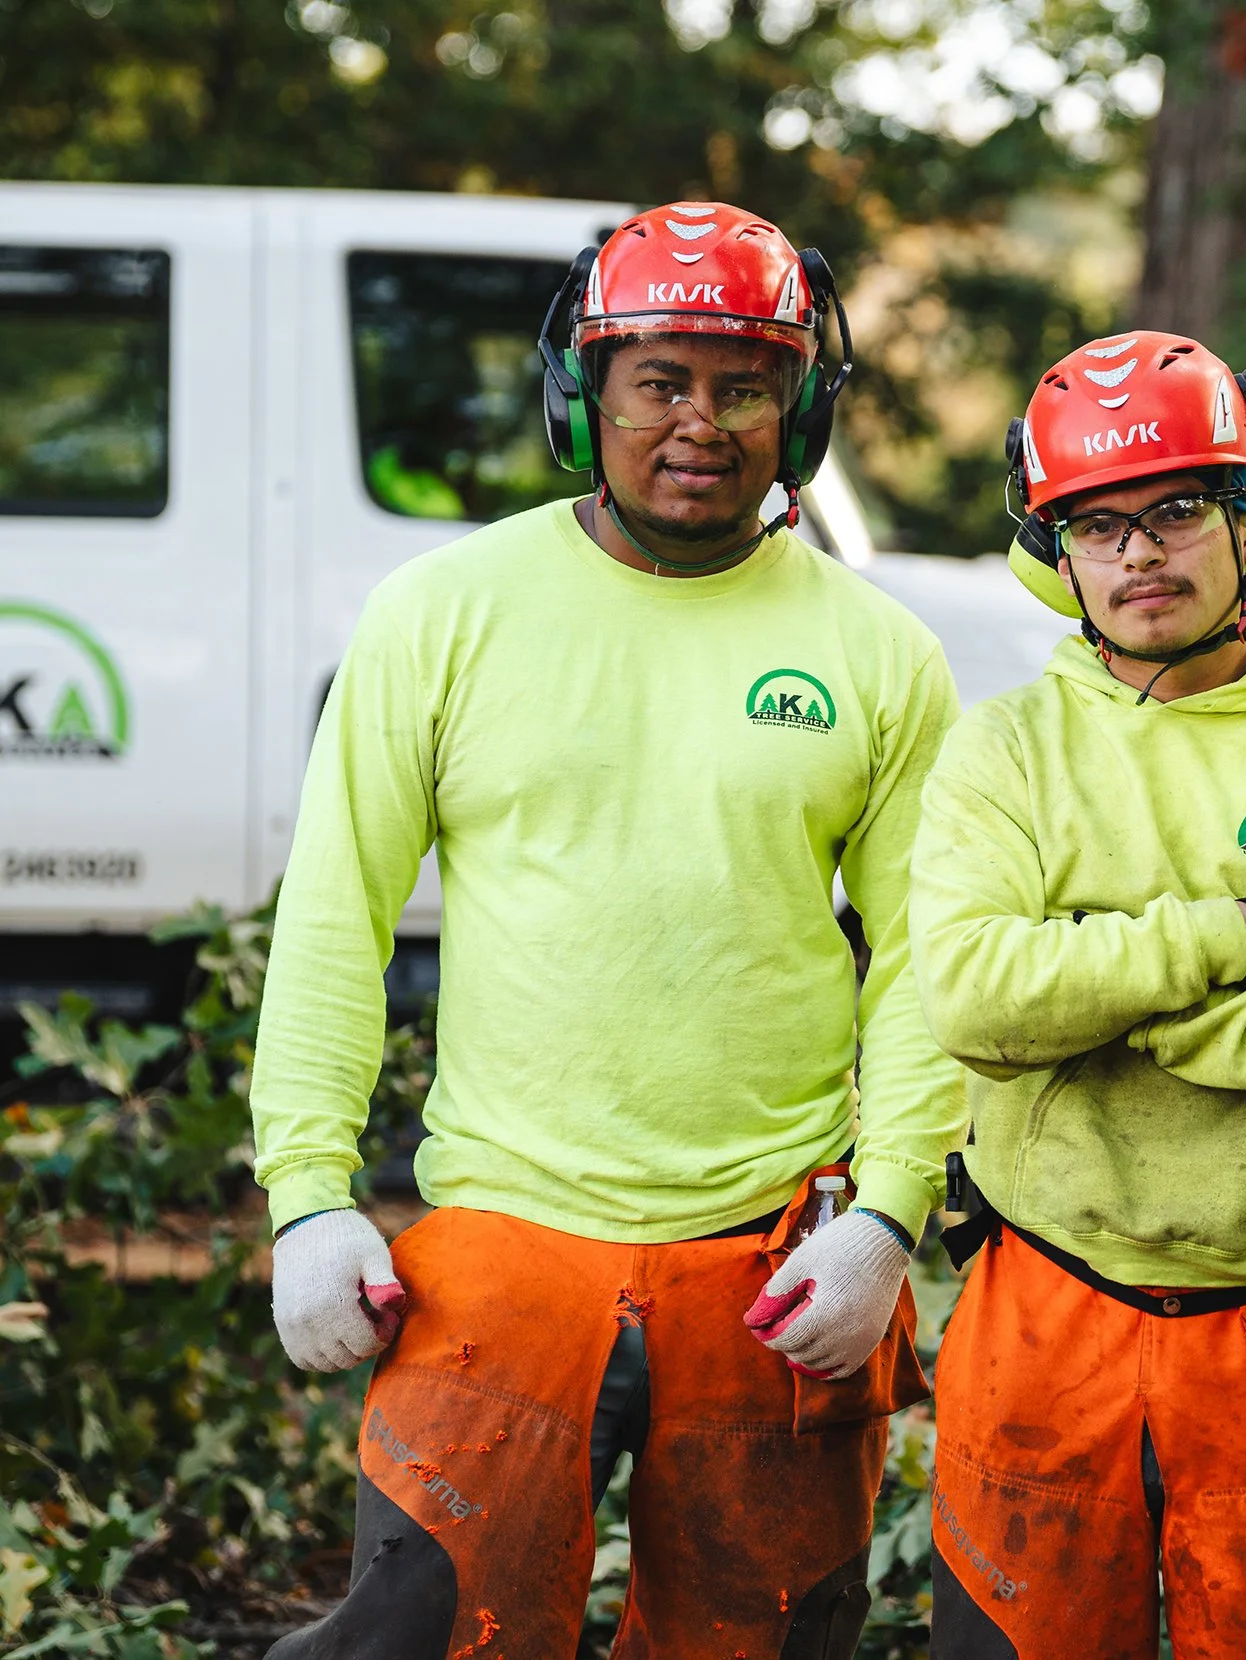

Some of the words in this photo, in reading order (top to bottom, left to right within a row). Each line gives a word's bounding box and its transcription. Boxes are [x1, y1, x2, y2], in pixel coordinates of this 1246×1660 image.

[648, 282, 725, 305] KASK
[1083, 421, 1162, 457] KASK
[752, 719, 786, 728] Licensed
[787, 722, 801, 730] and
[802, 725, 829, 735] Insured
[756, 713, 781, 721] TREE
[784, 715, 827, 728] SERVICE
